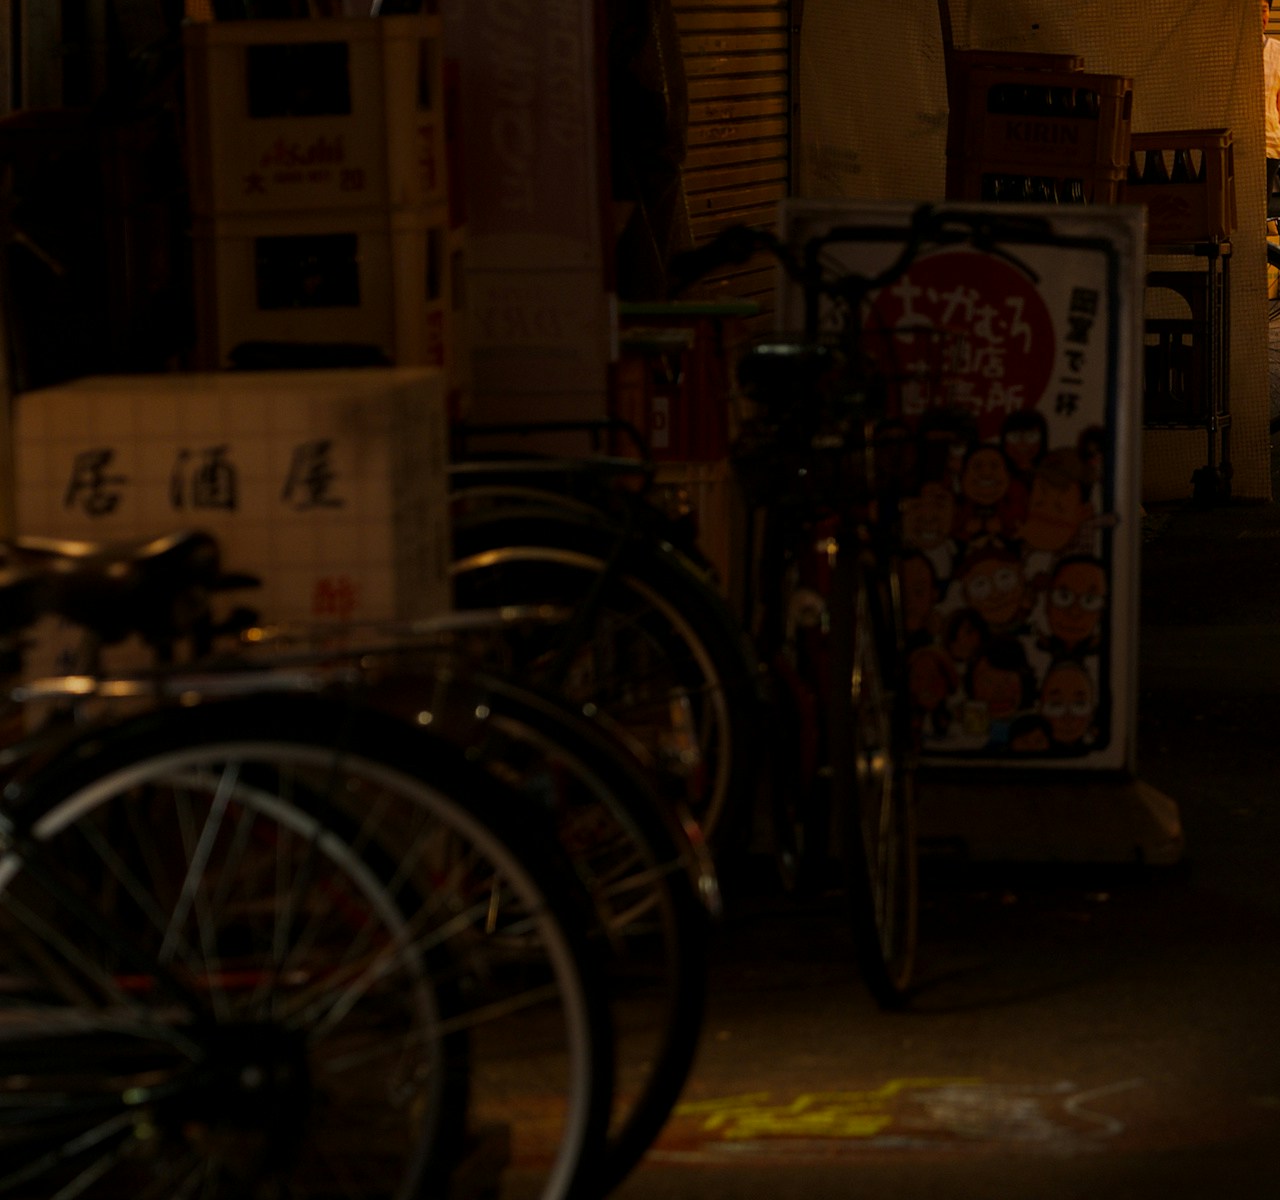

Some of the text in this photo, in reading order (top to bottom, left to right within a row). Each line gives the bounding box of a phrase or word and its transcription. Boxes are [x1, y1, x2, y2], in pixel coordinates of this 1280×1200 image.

[1005, 122, 1079, 146] KIRIN
[64, 438, 343, 518] 居酒屋
